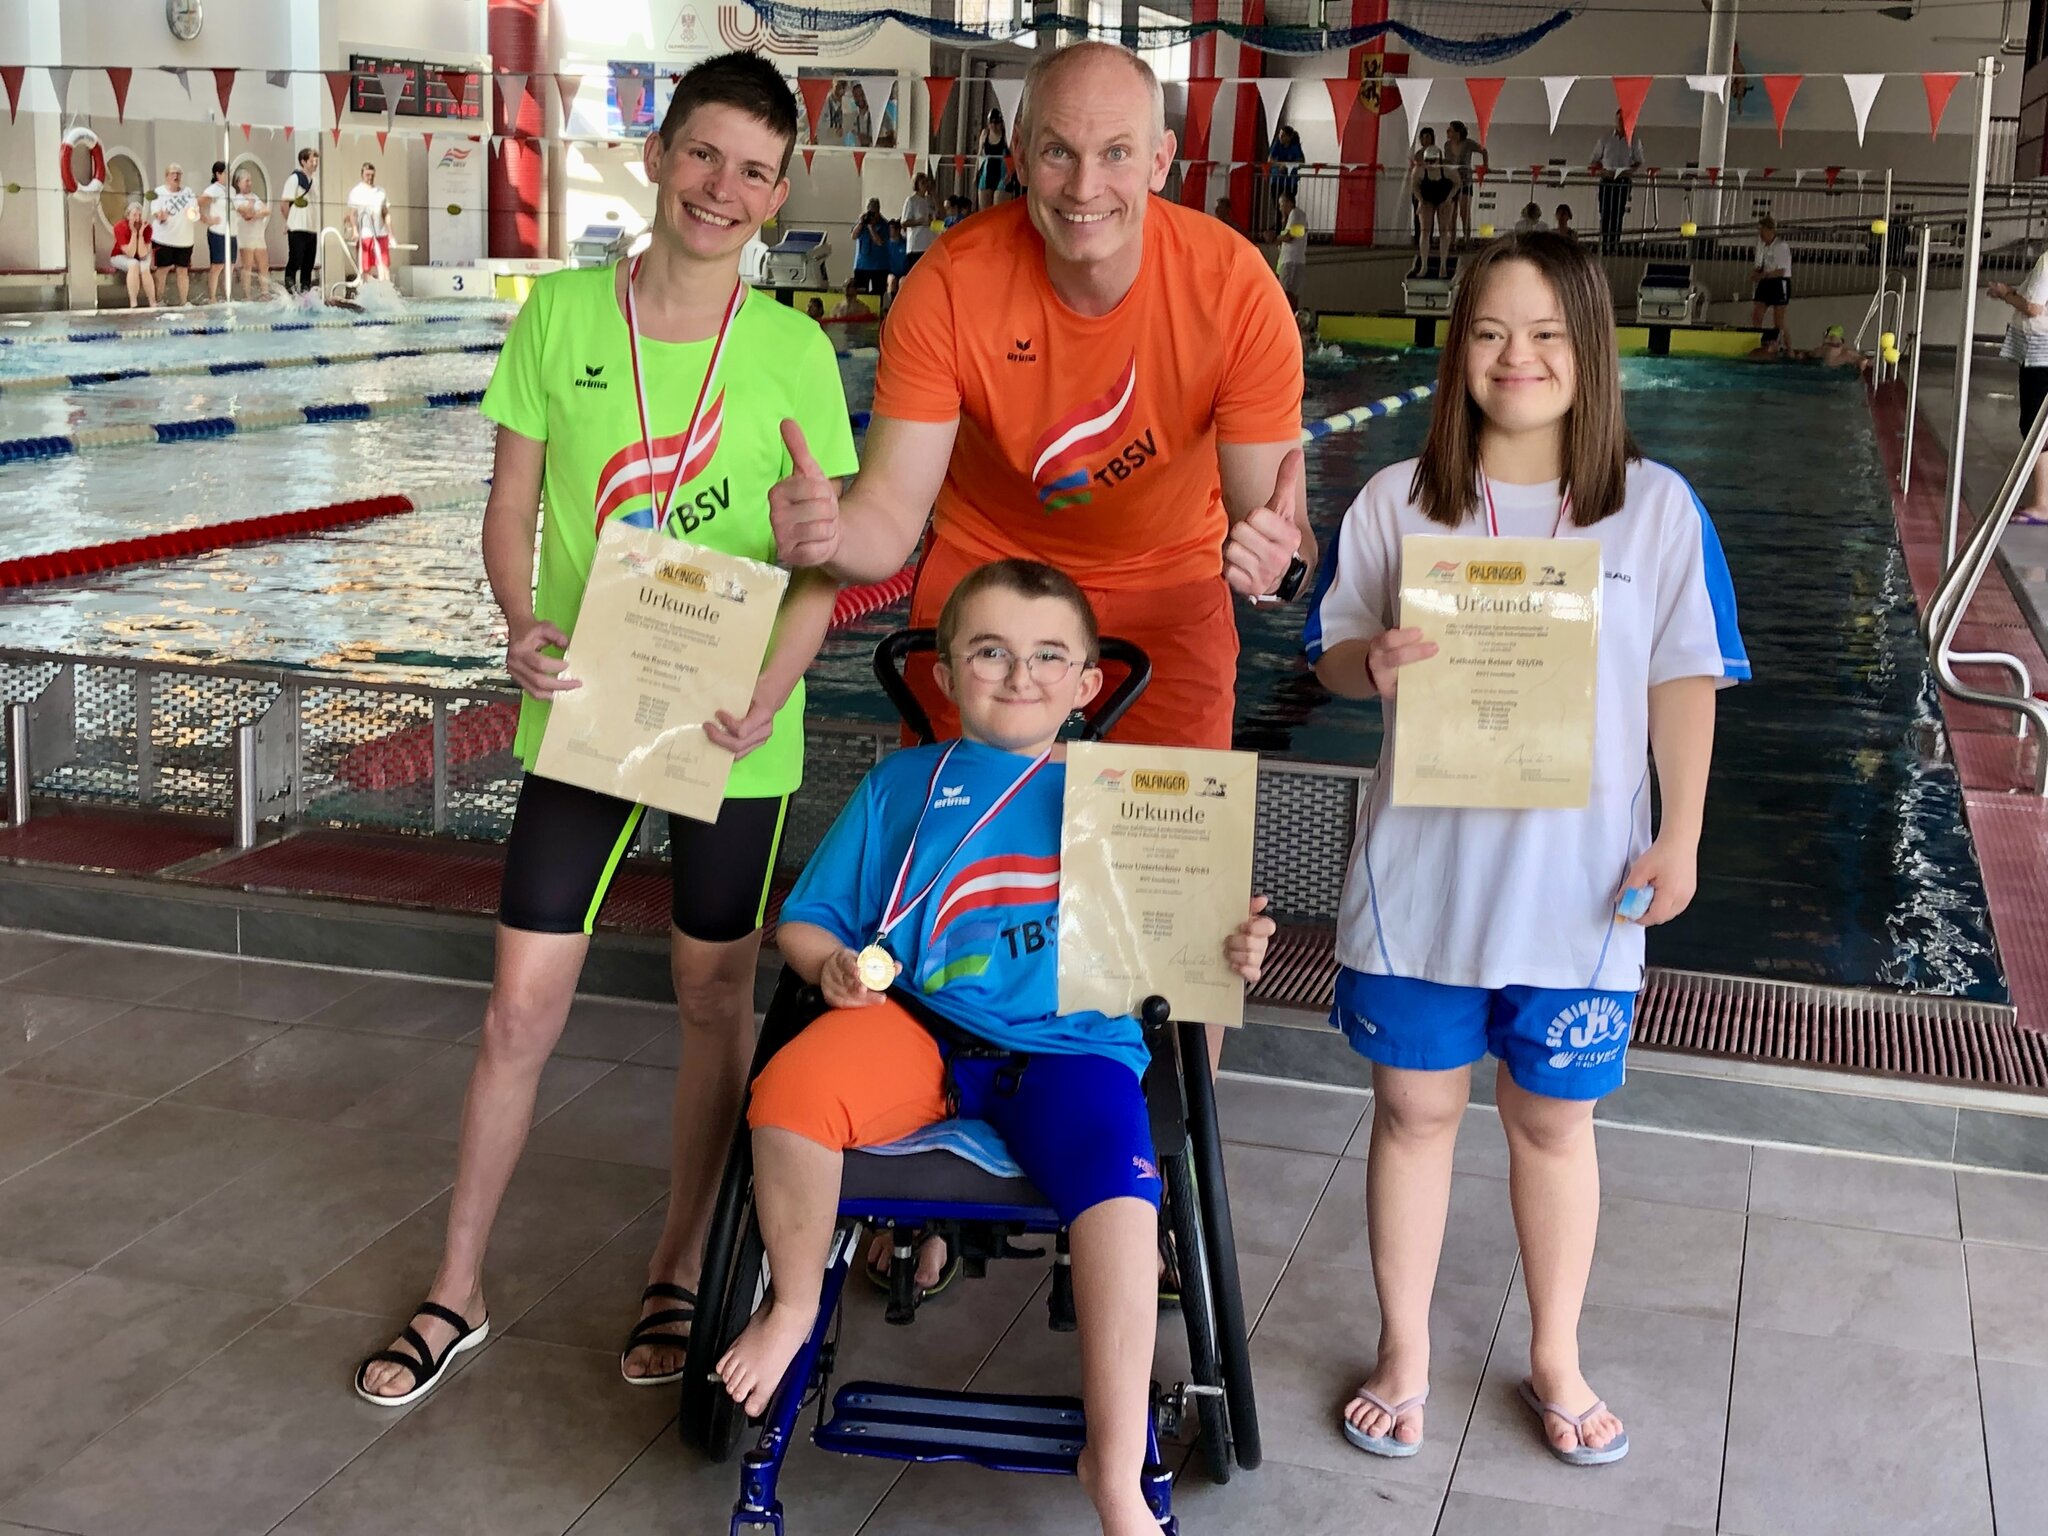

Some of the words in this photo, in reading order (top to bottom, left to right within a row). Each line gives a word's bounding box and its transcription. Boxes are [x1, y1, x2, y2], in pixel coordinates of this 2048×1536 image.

[452, 275, 464, 291] 3
[789, 268, 800, 281] 2
[1425, 295, 1436, 308] 5
[1658, 304, 1670, 317] 6
[1007, 352, 1037, 363] erima
[575, 377, 608, 390] erima
[1094, 428, 1157, 488] TBSV
[666, 476, 730, 539] TBSV
[1469, 564, 1523, 582] PALFINGER
[639, 586, 721, 624] Urkunde
[1455, 593, 1544, 613] Urkunde
[1135, 773, 1186, 791] PALFINGER
[934, 795, 971, 809] erima
[1120, 801, 1206, 824] Urkunde
